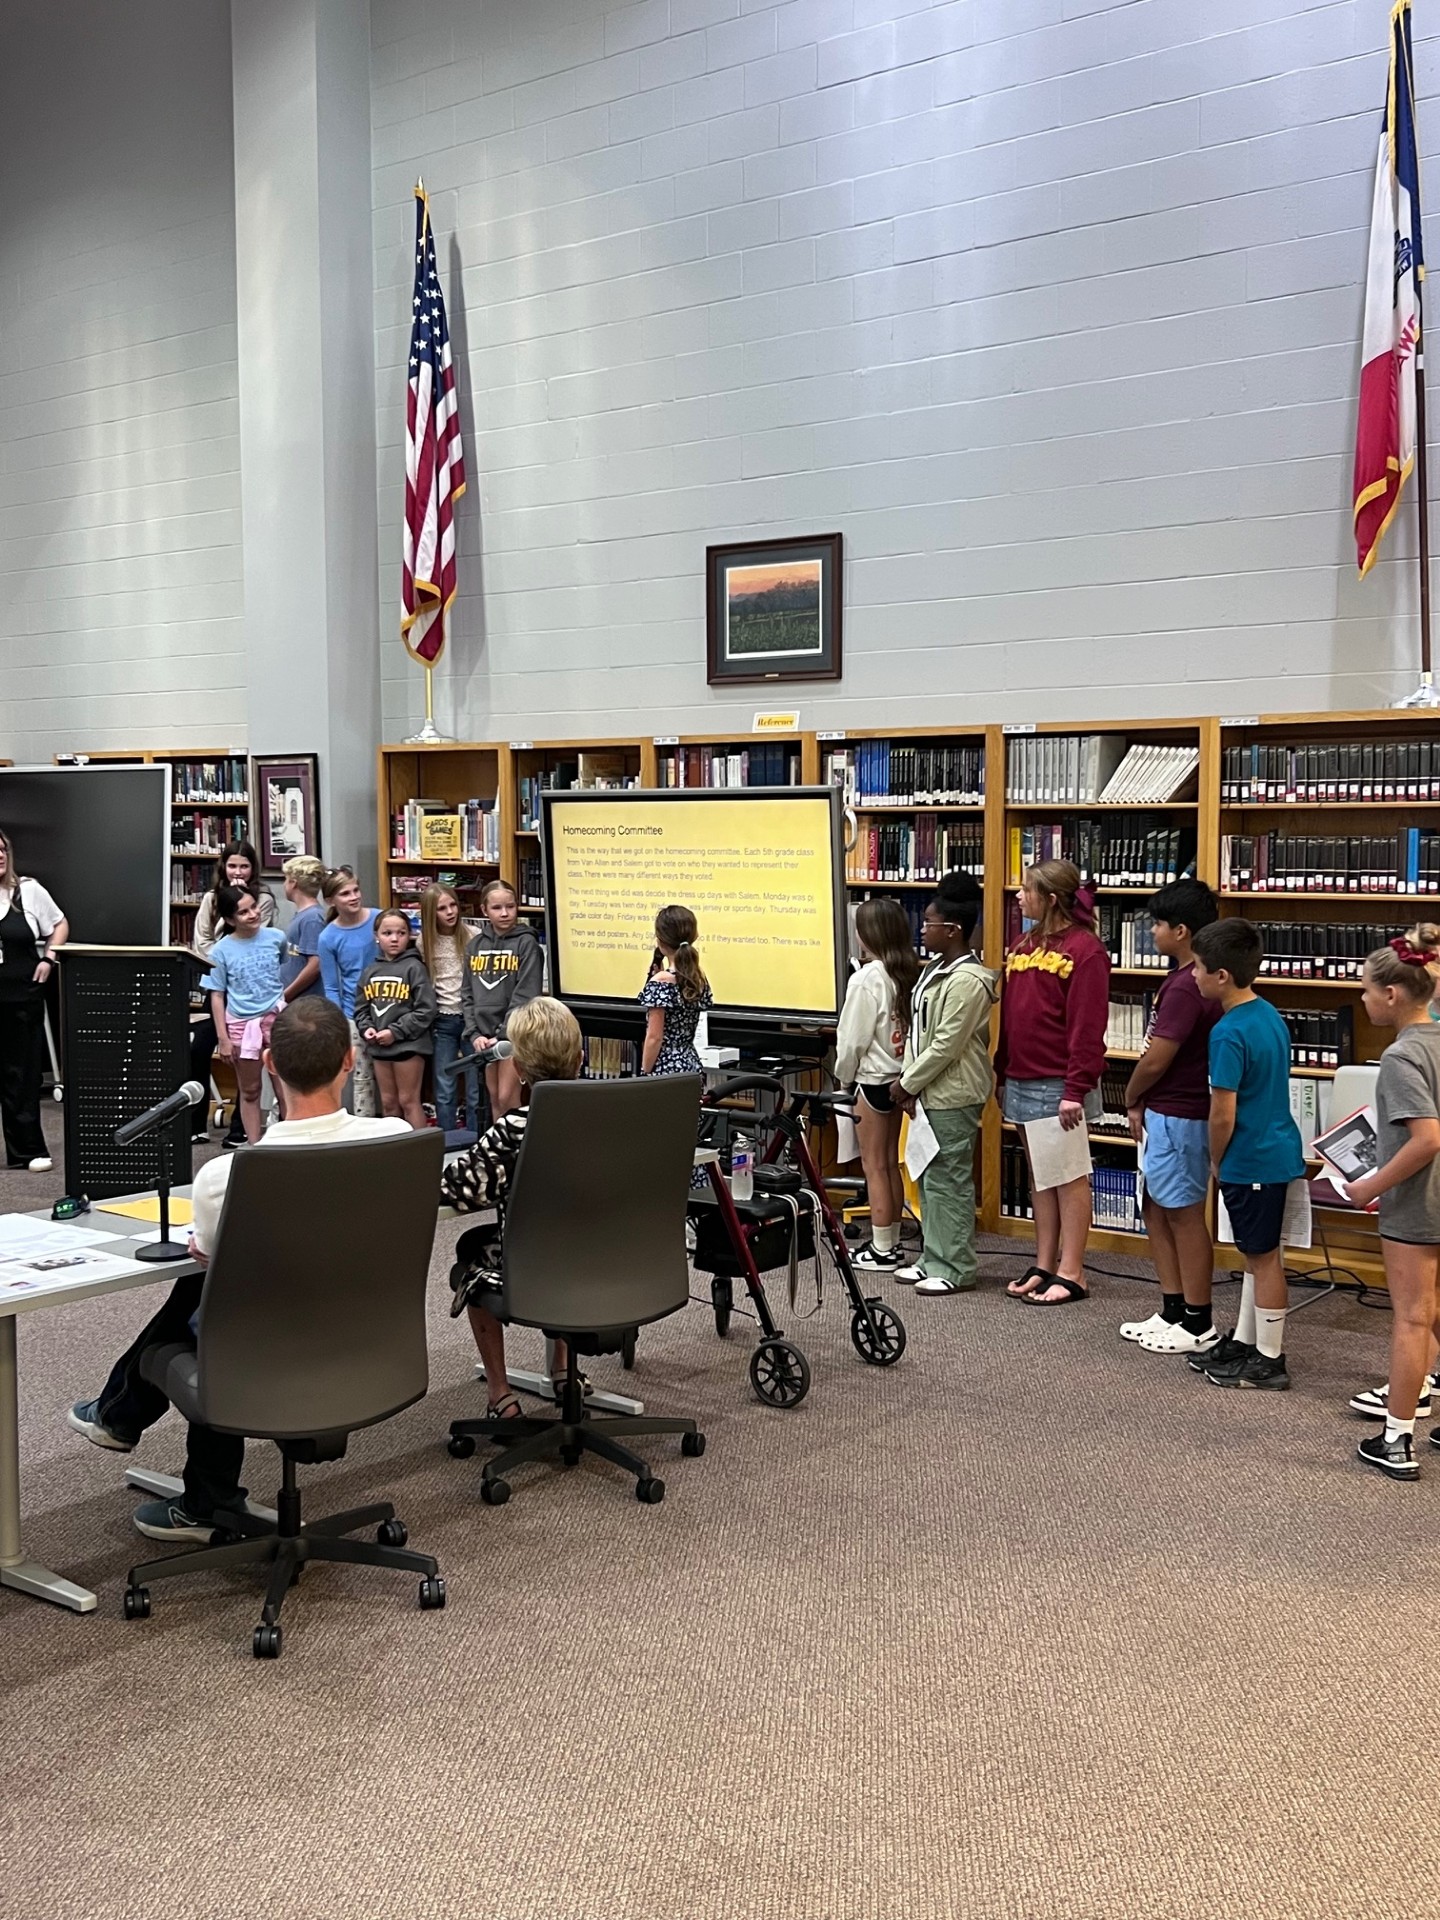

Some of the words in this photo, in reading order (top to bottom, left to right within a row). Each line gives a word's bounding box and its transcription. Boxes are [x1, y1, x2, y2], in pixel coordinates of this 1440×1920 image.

[563, 825, 616, 837] Homecoming
[618, 825, 664, 835] Committee
[666, 847, 706, 857] homecoming
[707, 847, 742, 855] committee.
[750, 860, 782, 870] represent
[636, 871, 661, 879] different
[645, 889, 666, 897] decide
[762, 892, 790, 902] Monday
[582, 899, 608, 909] Tuesday
[770, 905, 801, 915] Thursday
[470, 955, 488, 971] HOT
[493, 955, 518, 971] STIX
[363, 982, 381, 1001] HT
[381, 981, 410, 1000] STIX
